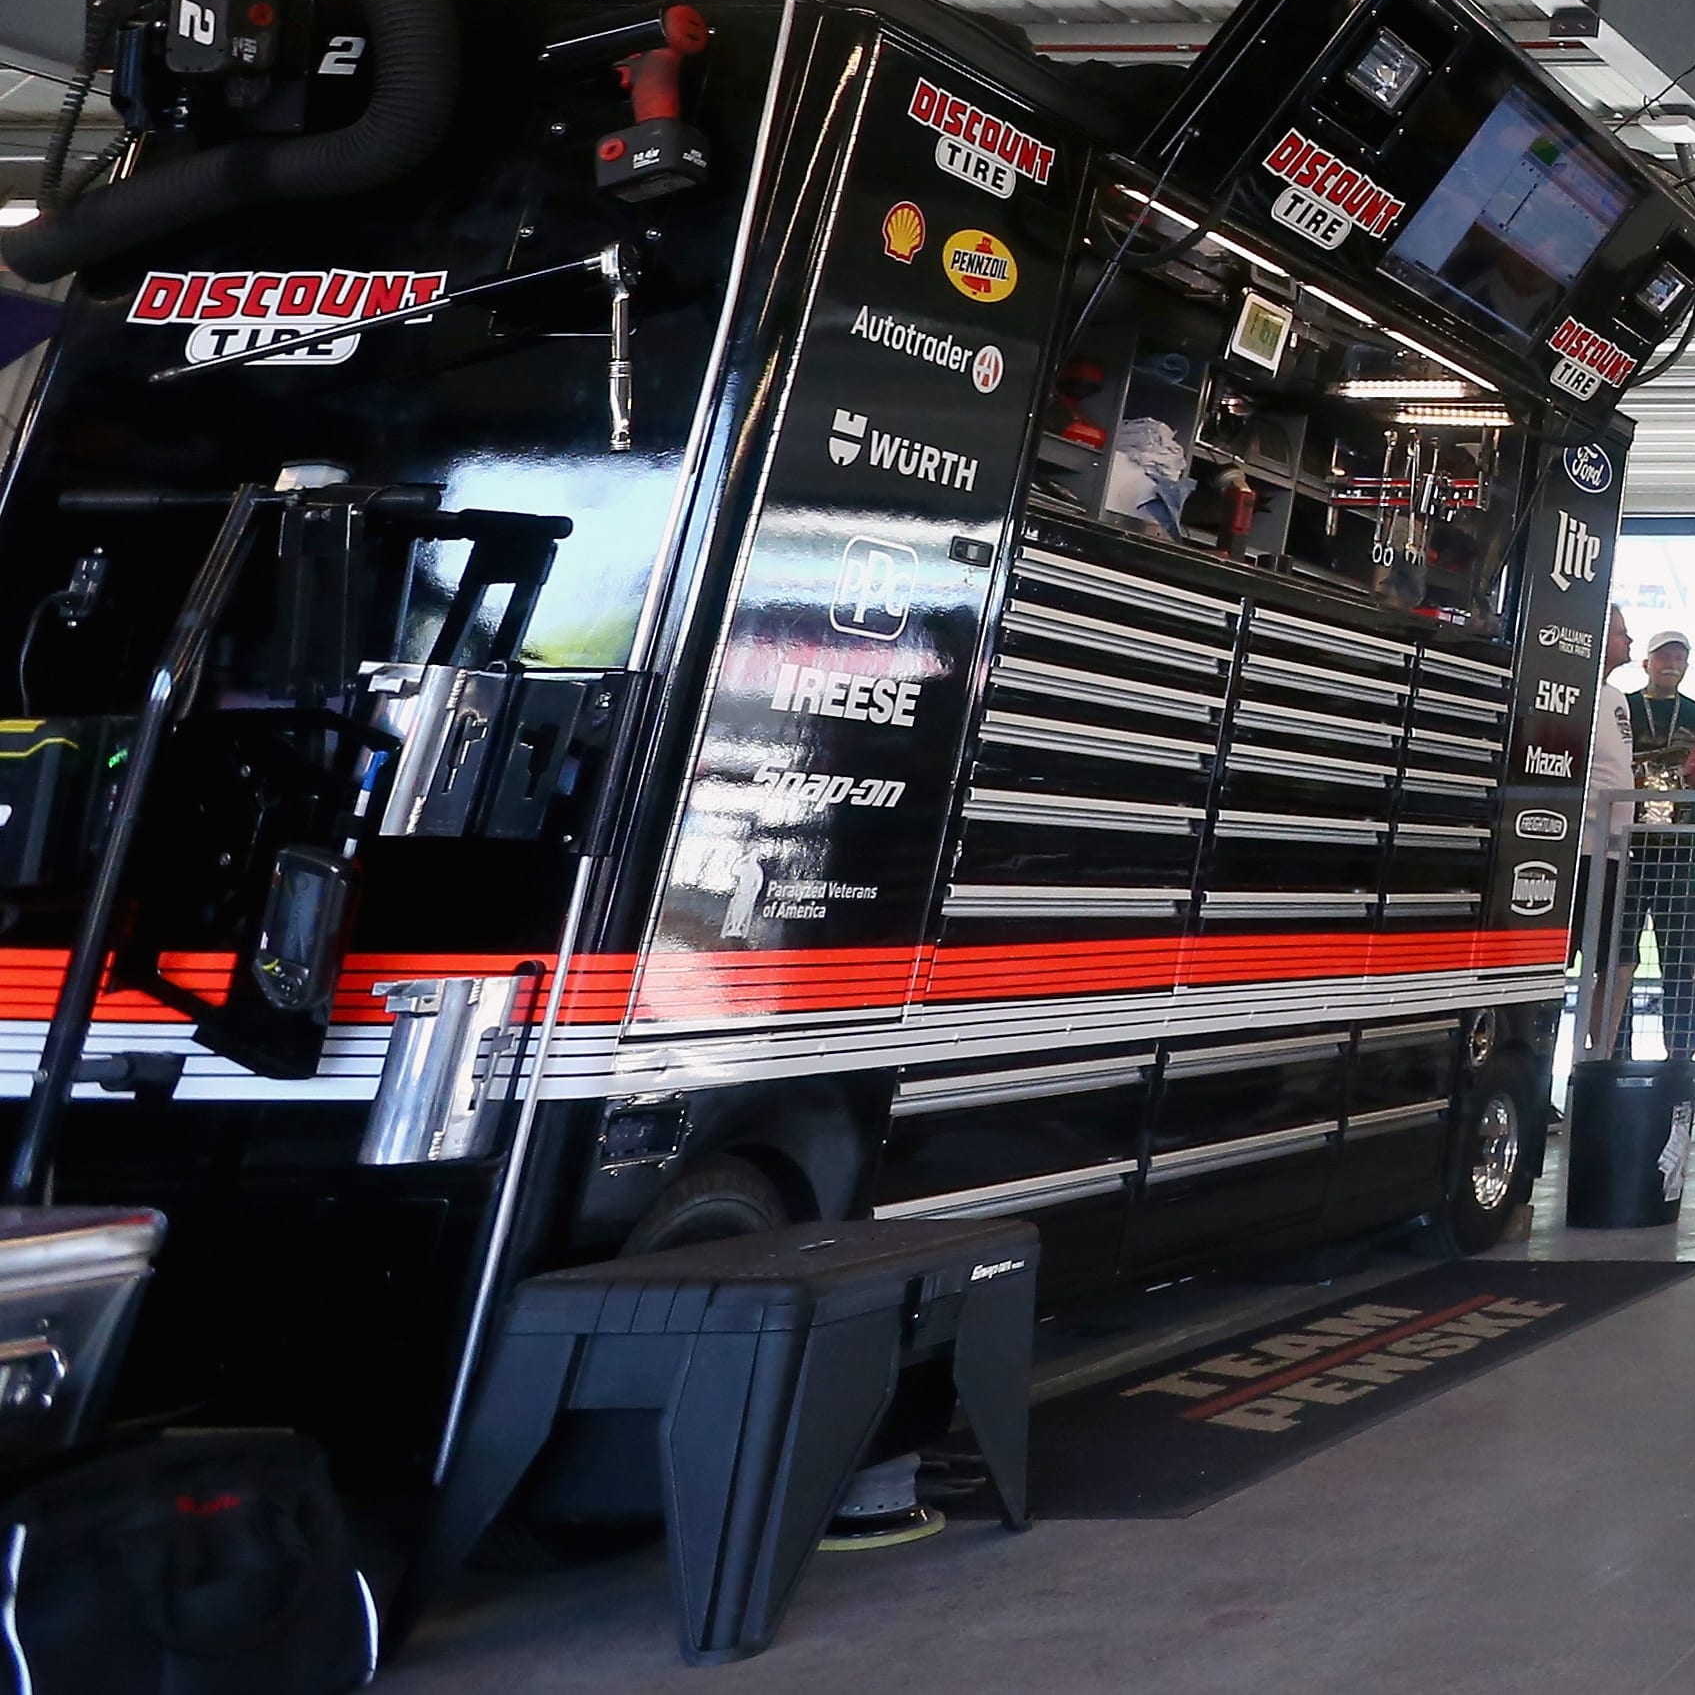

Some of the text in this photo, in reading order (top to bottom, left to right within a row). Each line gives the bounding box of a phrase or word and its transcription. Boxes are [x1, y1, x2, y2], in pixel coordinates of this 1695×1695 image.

[179, 0, 215, 45] 2
[317, 36, 366, 75] 2
[908, 77, 1055, 185] DISCOUNT
[947, 143, 1008, 191] TIRE
[1263, 128, 1405, 237] DISCOUNT
[1283, 193, 1343, 242] TIRE
[951, 250, 1009, 280] PENNZOIL
[128, 270, 446, 324] DISCOUNT
[851, 305, 973, 373] Autotrader
[1549, 317, 1637, 387] DISCOUNT
[1558, 362, 1596, 395] TIRE
[869, 430, 978, 492] WÜRTH
[1571, 445, 1604, 486] Ford
[1550, 510, 1600, 592] Lite
[1560, 626, 1593, 647] ALLIANCE
[791, 665, 921, 727] REESE
[1535, 679, 1580, 715] SKF
[754, 758, 906, 812] Snap-on
[1525, 744, 1574, 778] Mazak
[763, 901, 827, 919] of America
[828, 882, 878, 900] Veterans
[1119, 1304, 1424, 1399] TEAM
[1205, 1297, 1567, 1433] PENSKE
